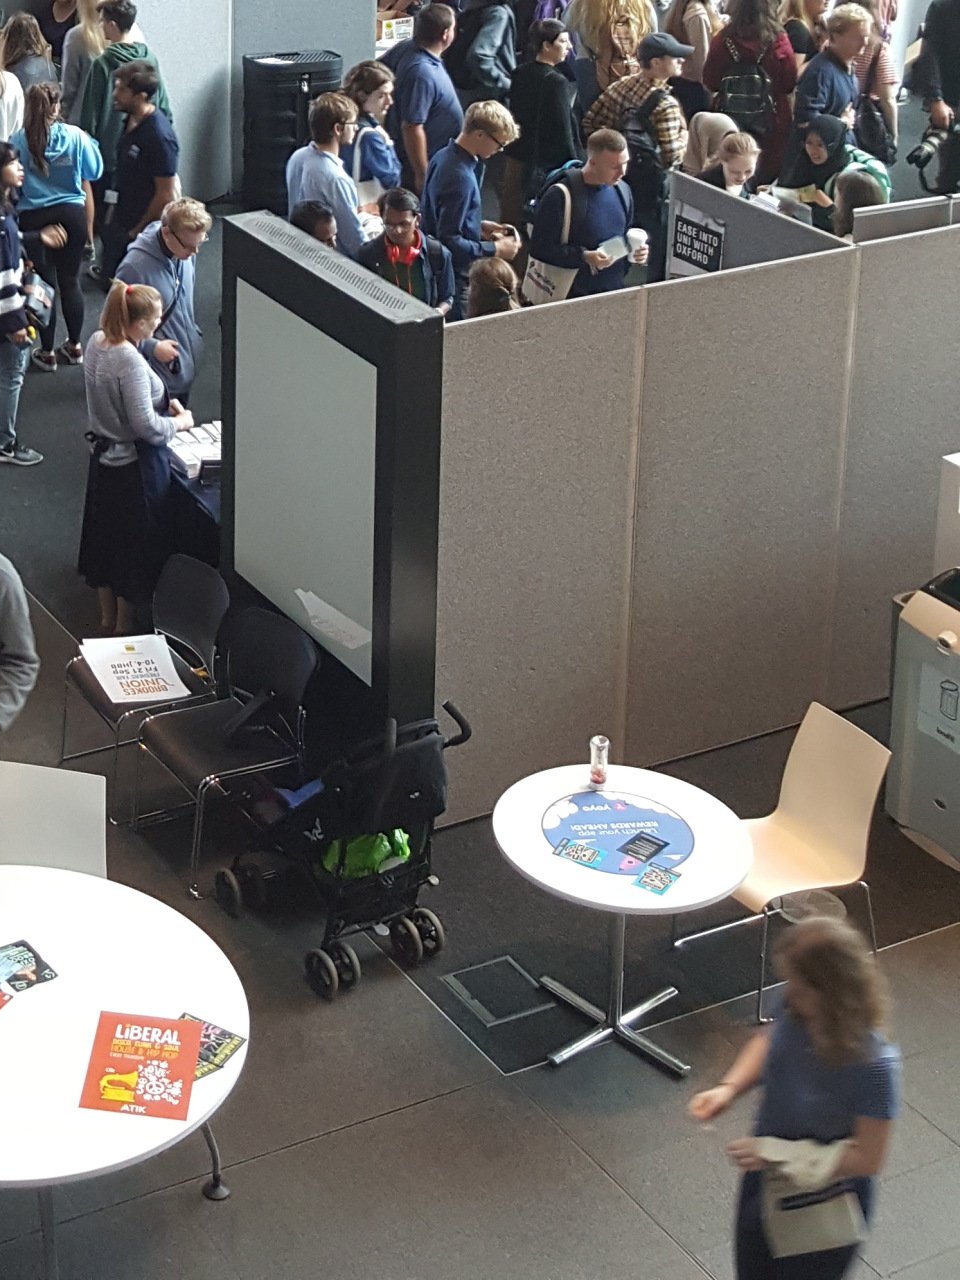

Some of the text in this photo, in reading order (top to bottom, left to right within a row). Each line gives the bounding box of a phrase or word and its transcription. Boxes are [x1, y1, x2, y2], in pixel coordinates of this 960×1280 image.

[677, 221, 718, 247] EASE INTO
[677, 232, 714, 256] UNI WITH
[676, 243, 708, 264] OXFORD
[113, 667, 130, 675] Sep
[119, 677, 174, 688] UNION
[123, 684, 169, 696] BROOKES
[608, 821, 659, 829] REWARDS
[598, 828, 621, 836] your
[120, 1104, 146, 1113] ATIK
